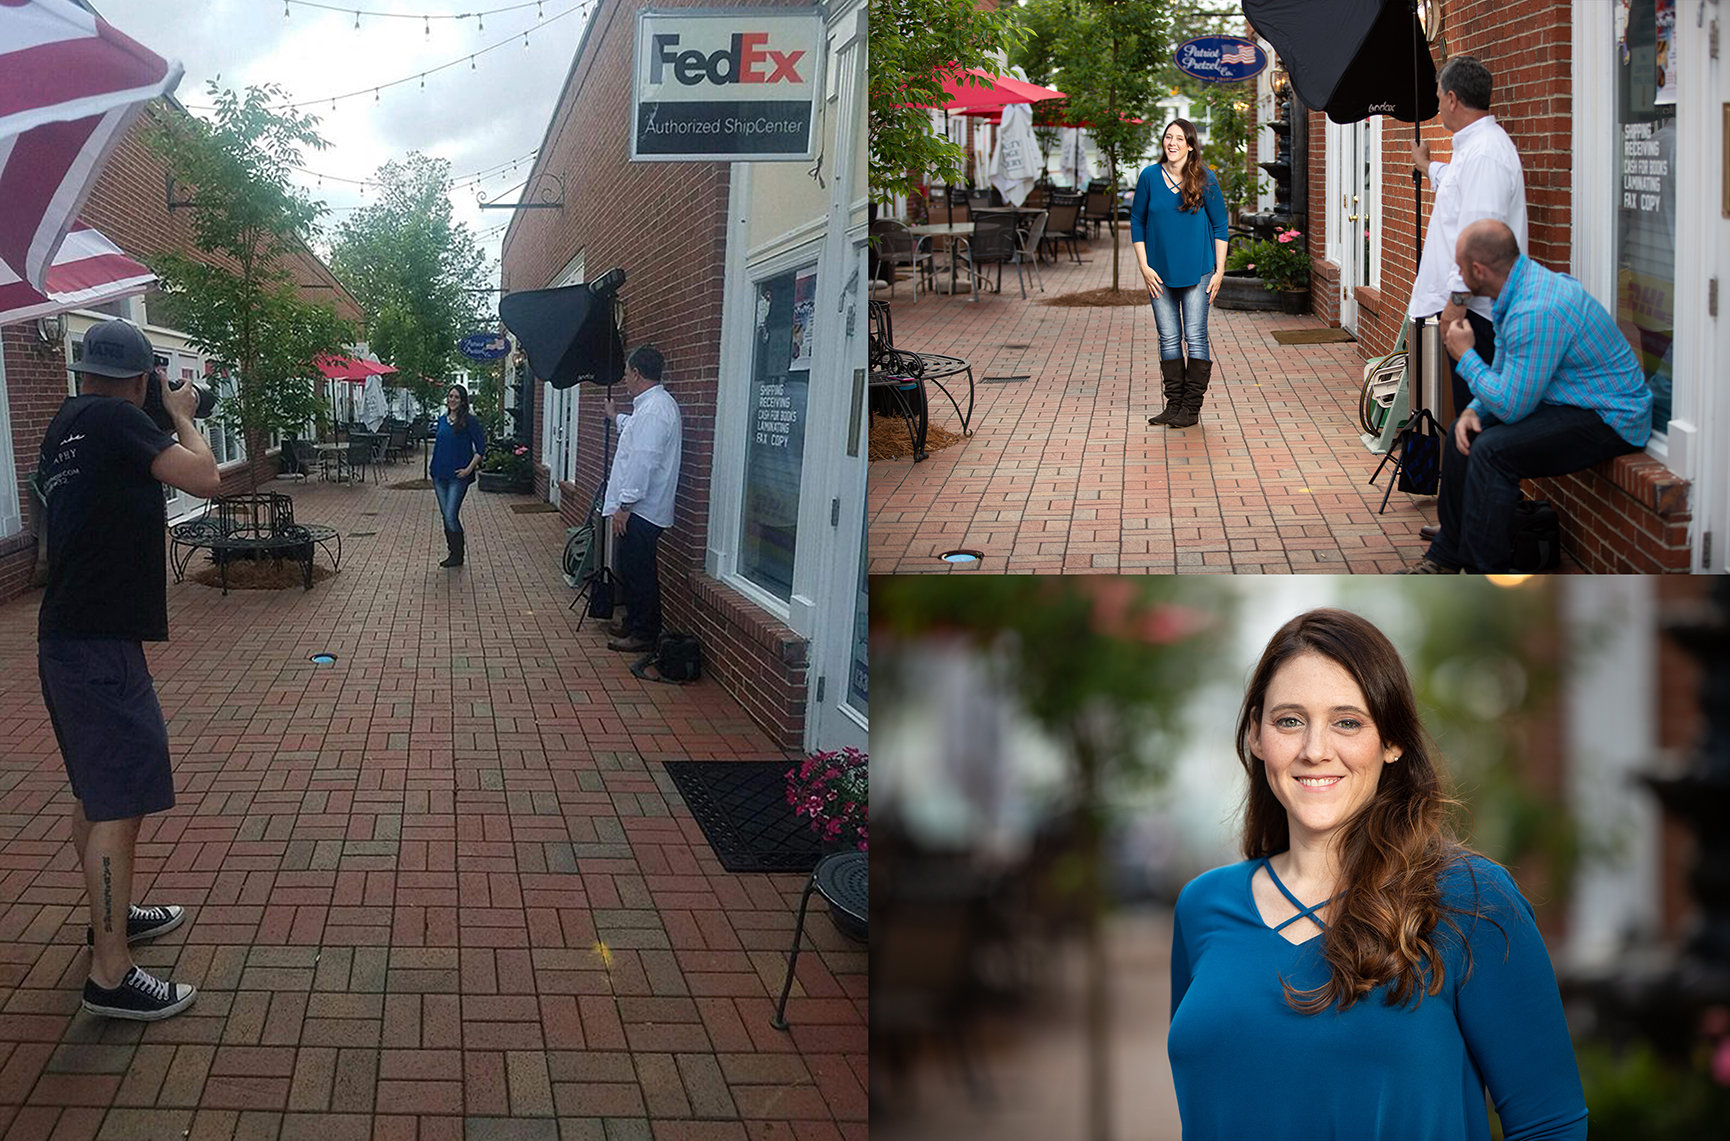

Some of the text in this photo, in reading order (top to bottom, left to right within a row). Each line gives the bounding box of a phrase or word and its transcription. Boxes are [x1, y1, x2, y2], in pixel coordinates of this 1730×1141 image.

[650, 33, 806, 85] FedEx
[1183, 44, 1220, 58] Patriot
[1182, 57, 1221, 72] Pretzel
[645, 118, 803, 136] Authorized ShipCenter
[1624, 122, 1652, 140] SHIPPING
[1624, 140, 1660, 157] RECEIVING
[1624, 159, 1668, 176] CASH FOR BOOKS
[1624, 174, 1661, 193] LAMINATING
[1624, 192, 1661, 213] FAX COPY
[760, 384, 784, 396] SHIPPING
[760, 397, 791, 408] RECEIVING
[770, 434, 789, 448] COPY
